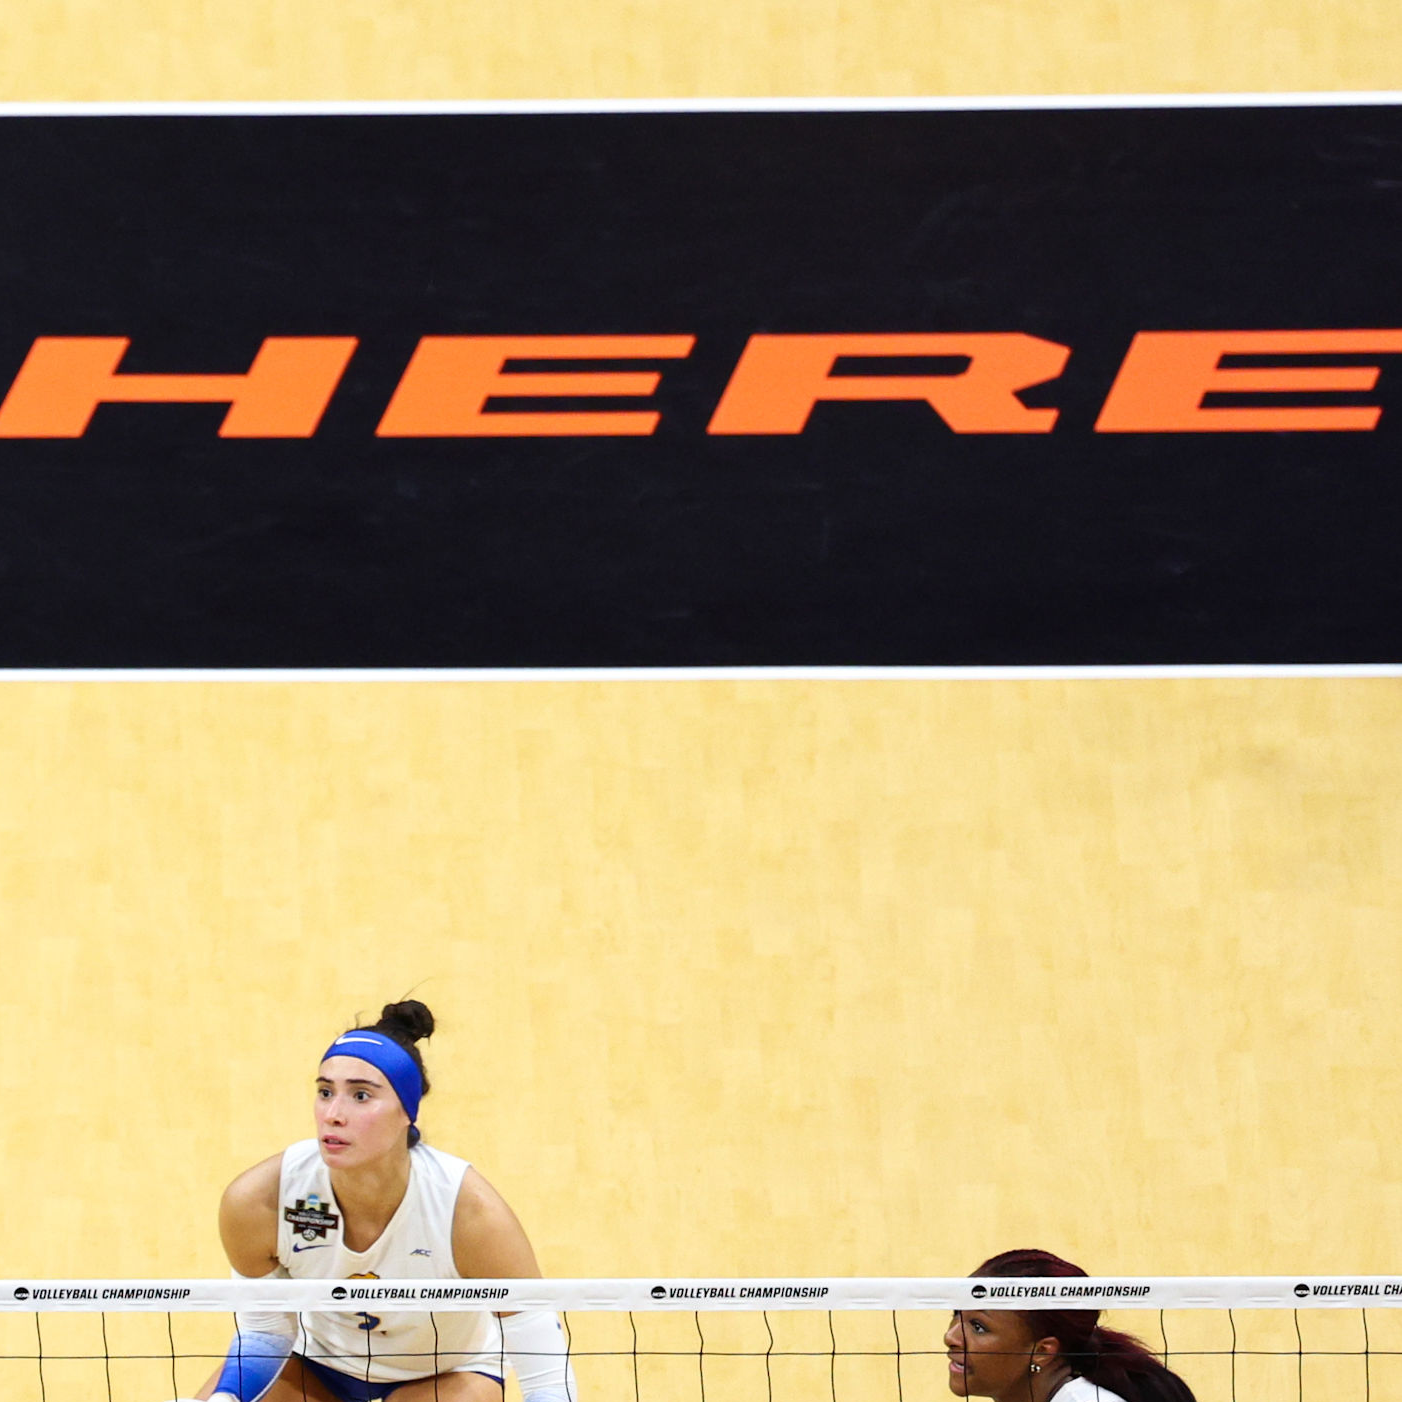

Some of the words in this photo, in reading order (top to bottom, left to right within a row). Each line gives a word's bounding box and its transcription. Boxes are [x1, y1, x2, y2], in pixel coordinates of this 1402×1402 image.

[32, 1289, 98, 1300] VOLLEYBALL
[102, 1289, 191, 1300] CHAMPIONSHIP
[350, 1288, 416, 1299] VOLLEYBALL
[420, 1288, 509, 1299] CHAMPIONSHIP
[669, 1287, 736, 1298] VOLLEYBALL
[739, 1287, 829, 1298] CHAMPIONSHIP
[990, 1286, 1056, 1297] VOLLEYBALL
[1060, 1286, 1151, 1297] CHAMPIONSHIP
[1313, 1285, 1380, 1296] VOLLEYBALL
